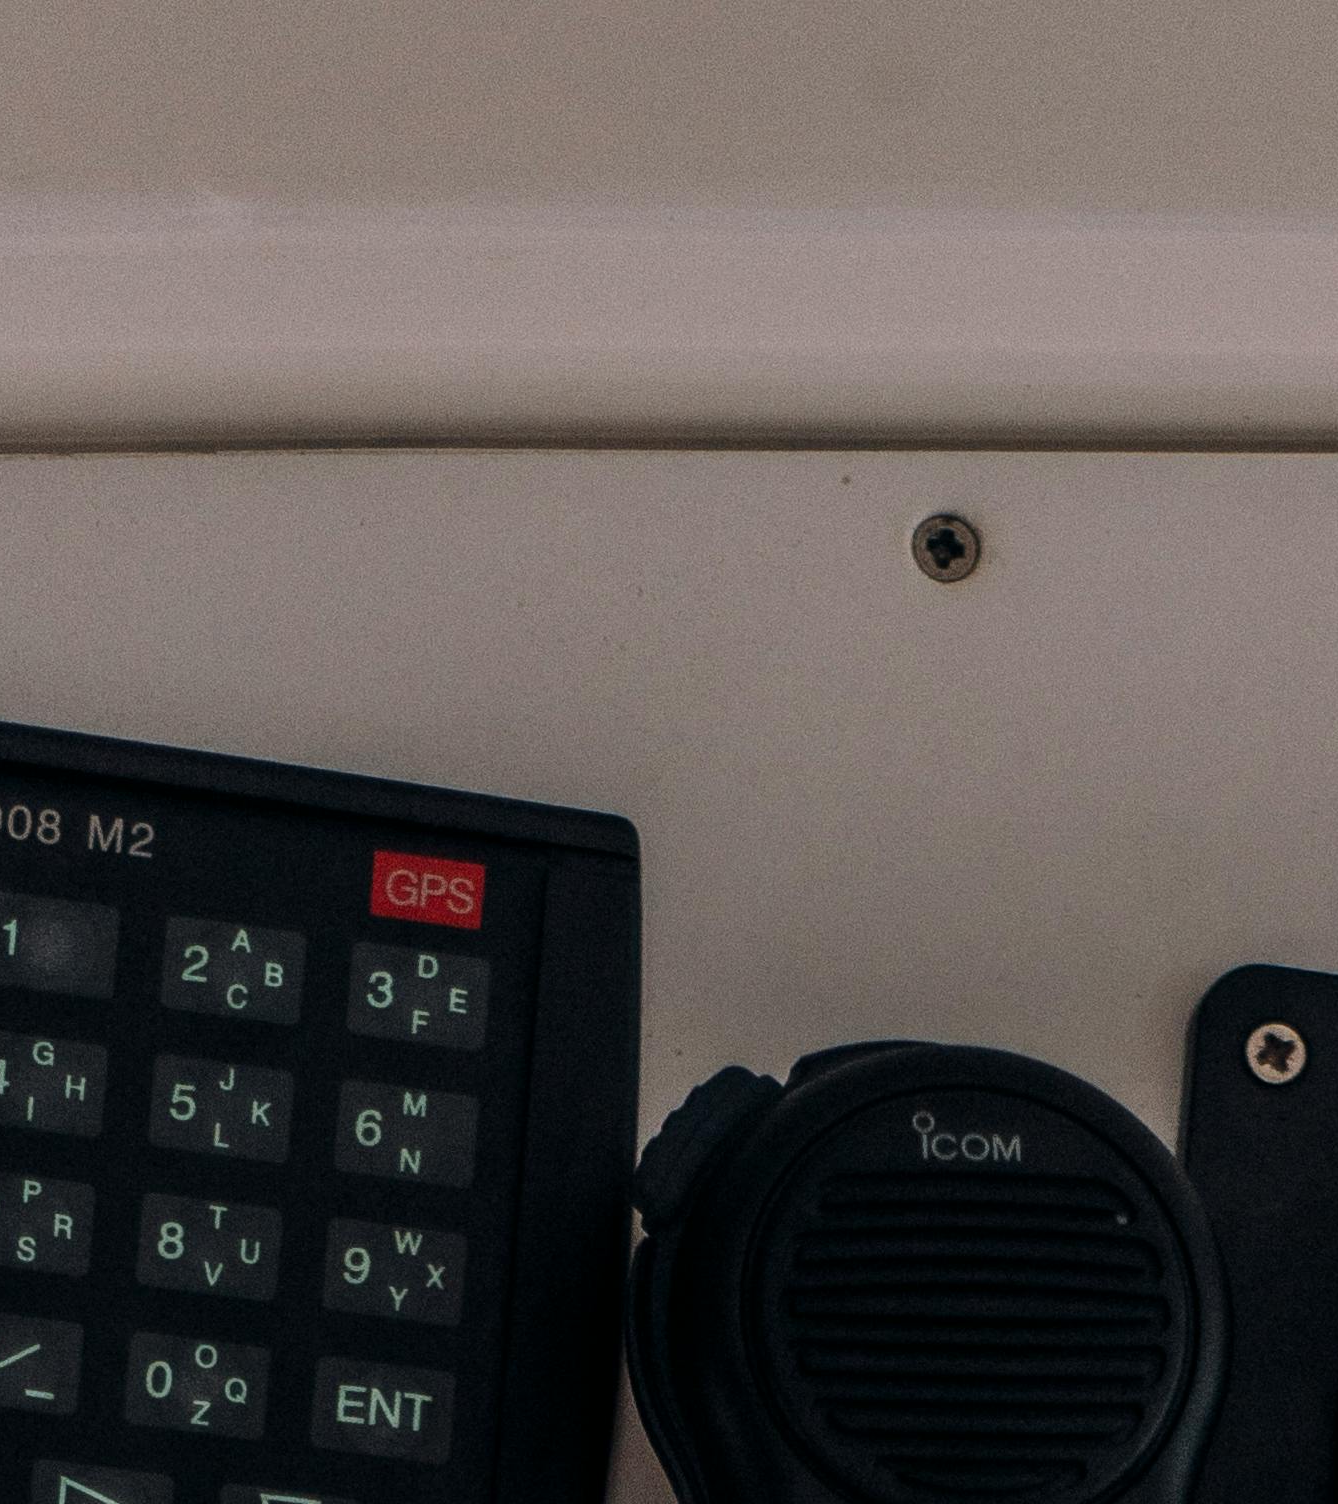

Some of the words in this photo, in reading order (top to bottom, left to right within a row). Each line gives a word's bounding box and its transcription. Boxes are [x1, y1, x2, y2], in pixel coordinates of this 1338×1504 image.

[88, 814, 155, 858] M2
[385, 868, 474, 915] GPS
[3, 919, 18, 955] 1
[231, 929, 251, 953] A
[181, 944, 210, 983] 2
[264, 961, 283, 988] B
[417, 954, 439, 979] D
[225, 982, 248, 1010] C
[367, 970, 394, 1009] 3
[449, 987, 466, 1014] E
[411, 1009, 429, 1034] F
[32, 1041, 55, 1066] G
[64, 1074, 87, 1100] H
[218, 1068, 236, 1092] J
[169, 1083, 197, 1121] 5
[251, 1101, 270, 1125] K
[403, 1092, 427, 1116] M
[213, 1122, 229, 1148] L
[355, 1109, 382, 1147] 6
[400, 1147, 421, 1173] N
[22, 1179, 42, 1203] P
[53, 1213, 73, 1238] R
[209, 1204, 227, 1229] T
[16, 1235, 36, 1262] S
[157, 1221, 184, 1260] 8
[239, 1238, 261, 1265] U
[394, 1231, 422, 1255] W
[203, 1261, 224, 1286] V
[343, 1246, 371, 1285] 9
[427, 1264, 444, 1287] X
[389, 1285, 408, 1310] Y
[223, 1377, 248, 1404] Q
[191, 1399, 211, 1425] Z
[336, 1384, 431, 1431] ENT
